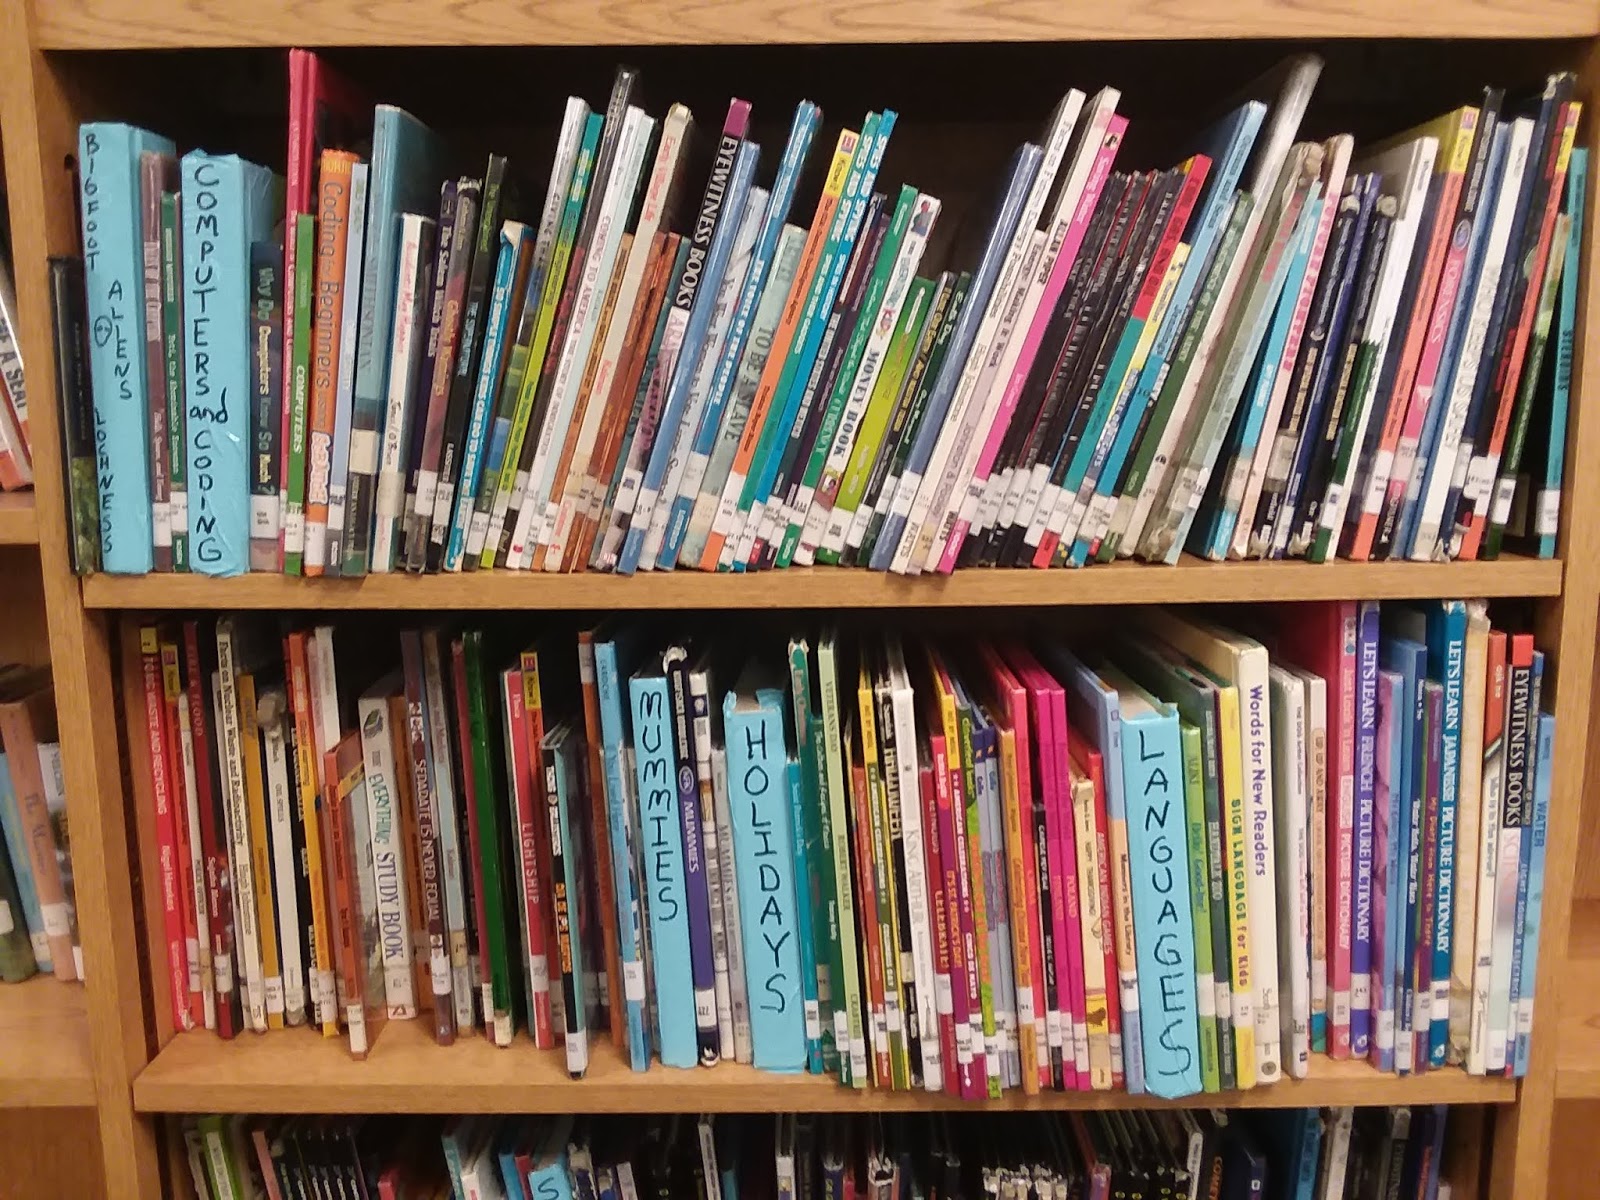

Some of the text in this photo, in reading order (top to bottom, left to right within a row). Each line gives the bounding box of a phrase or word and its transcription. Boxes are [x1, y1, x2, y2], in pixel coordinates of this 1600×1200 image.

[674, 135, 739, 310] EYEWITNESS BOOKS
[833, 410, 862, 460] BOOK
[1448, 640, 1462, 679] LET'S
[223, 685, 234, 726] Nuclear
[1446, 680, 1461, 730] LEARN
[150, 729, 162, 753] AND
[229, 759, 239, 778] and
[1506, 669, 1531, 827] EYEWITNESS BOOKS
[153, 754, 168, 816] RECYCLING
[414, 759, 431, 821] SEPARATE
[1249, 685, 1268, 876] Words for New Readers
[1356, 641, 1377, 943] LET'S LEARN FRENCH PICTURE DICTIONARY
[229, 779, 245, 847] Radioactivity
[420, 825, 433, 837] IS
[1439, 806, 1455, 867] PICTURE
[1534, 800, 1549, 848] WATER
[376, 852, 399, 906] STUDY
[521, 822, 540, 905] LIGHTSHIP
[745, 718, 792, 1014] HOLIDAYS
[426, 882, 440, 921] EQUAL
[1437, 868, 1452, 954] DICTIONARY
[381, 911, 404, 960] BOOK
